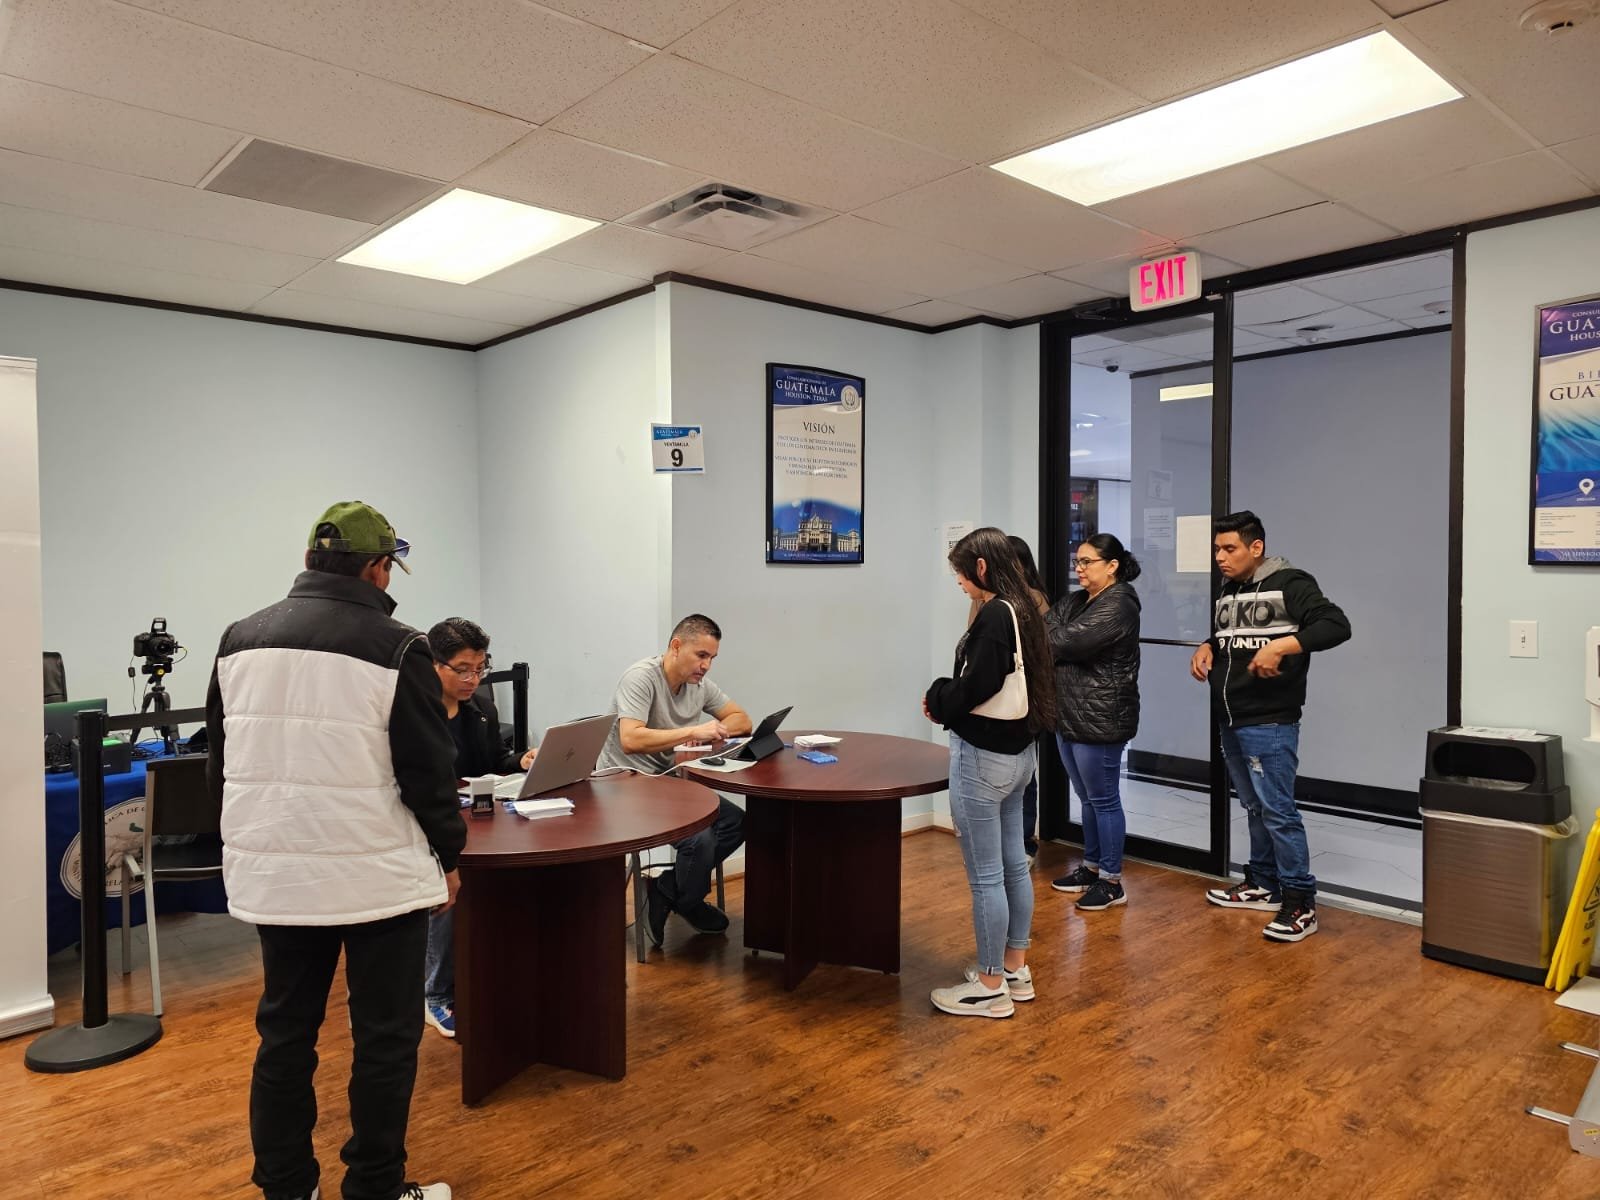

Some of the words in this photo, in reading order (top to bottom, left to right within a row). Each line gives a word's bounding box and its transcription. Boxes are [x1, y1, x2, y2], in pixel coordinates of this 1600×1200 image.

[1140, 256, 1187, 304] EXIT
[1549, 317, 1600, 334] GUA
[776, 379, 836, 397] GUATEMALA
[1549, 384, 1600, 401] GUA
[803, 421, 835, 434] VISIÓN
[671, 448, 684, 468] 9
